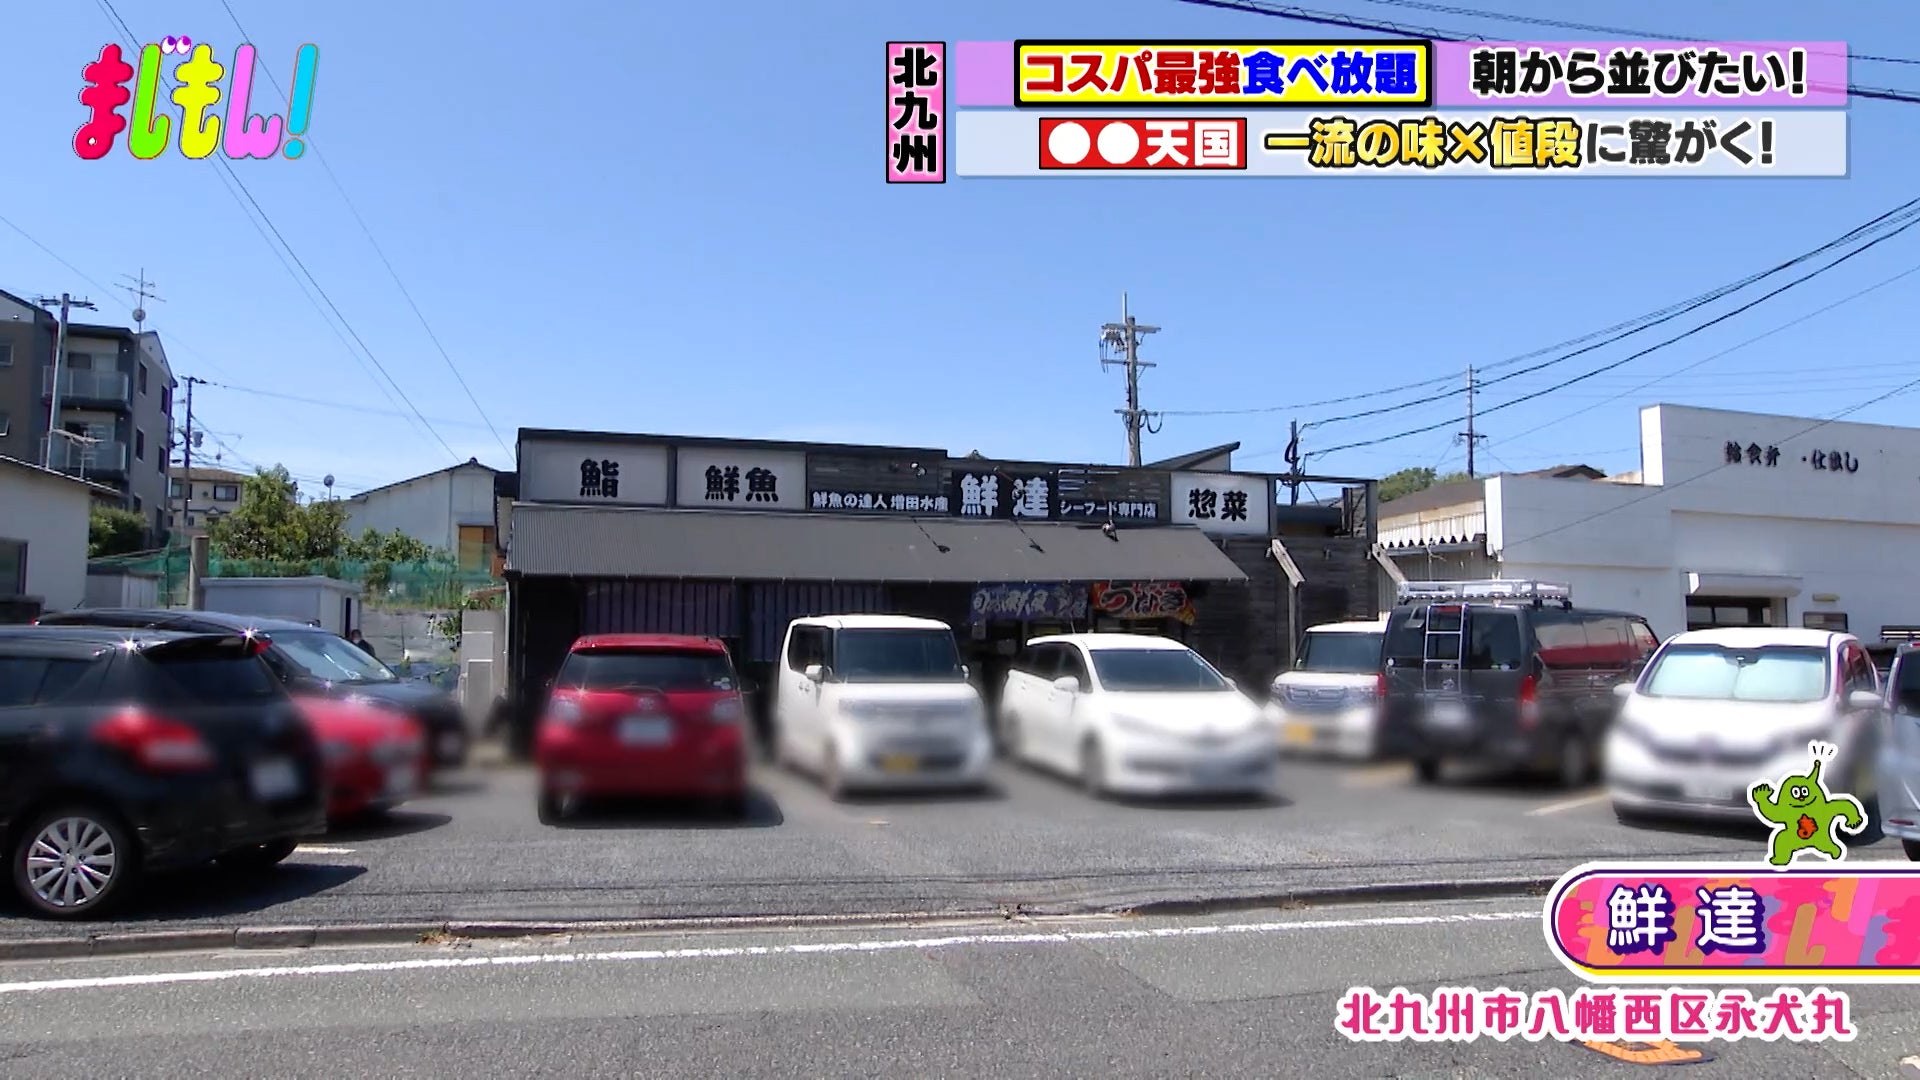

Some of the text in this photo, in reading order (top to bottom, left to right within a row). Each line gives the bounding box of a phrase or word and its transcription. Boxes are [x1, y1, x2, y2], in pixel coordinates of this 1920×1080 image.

[579, 457, 620, 499] 鮨
[704, 464, 779, 502] 鮮魚
[811, 491, 888, 511] 鮮魚の達人
[1058, 501, 1157, 520] シーフード専門店
[1188, 488, 1249, 522] 惣菜
